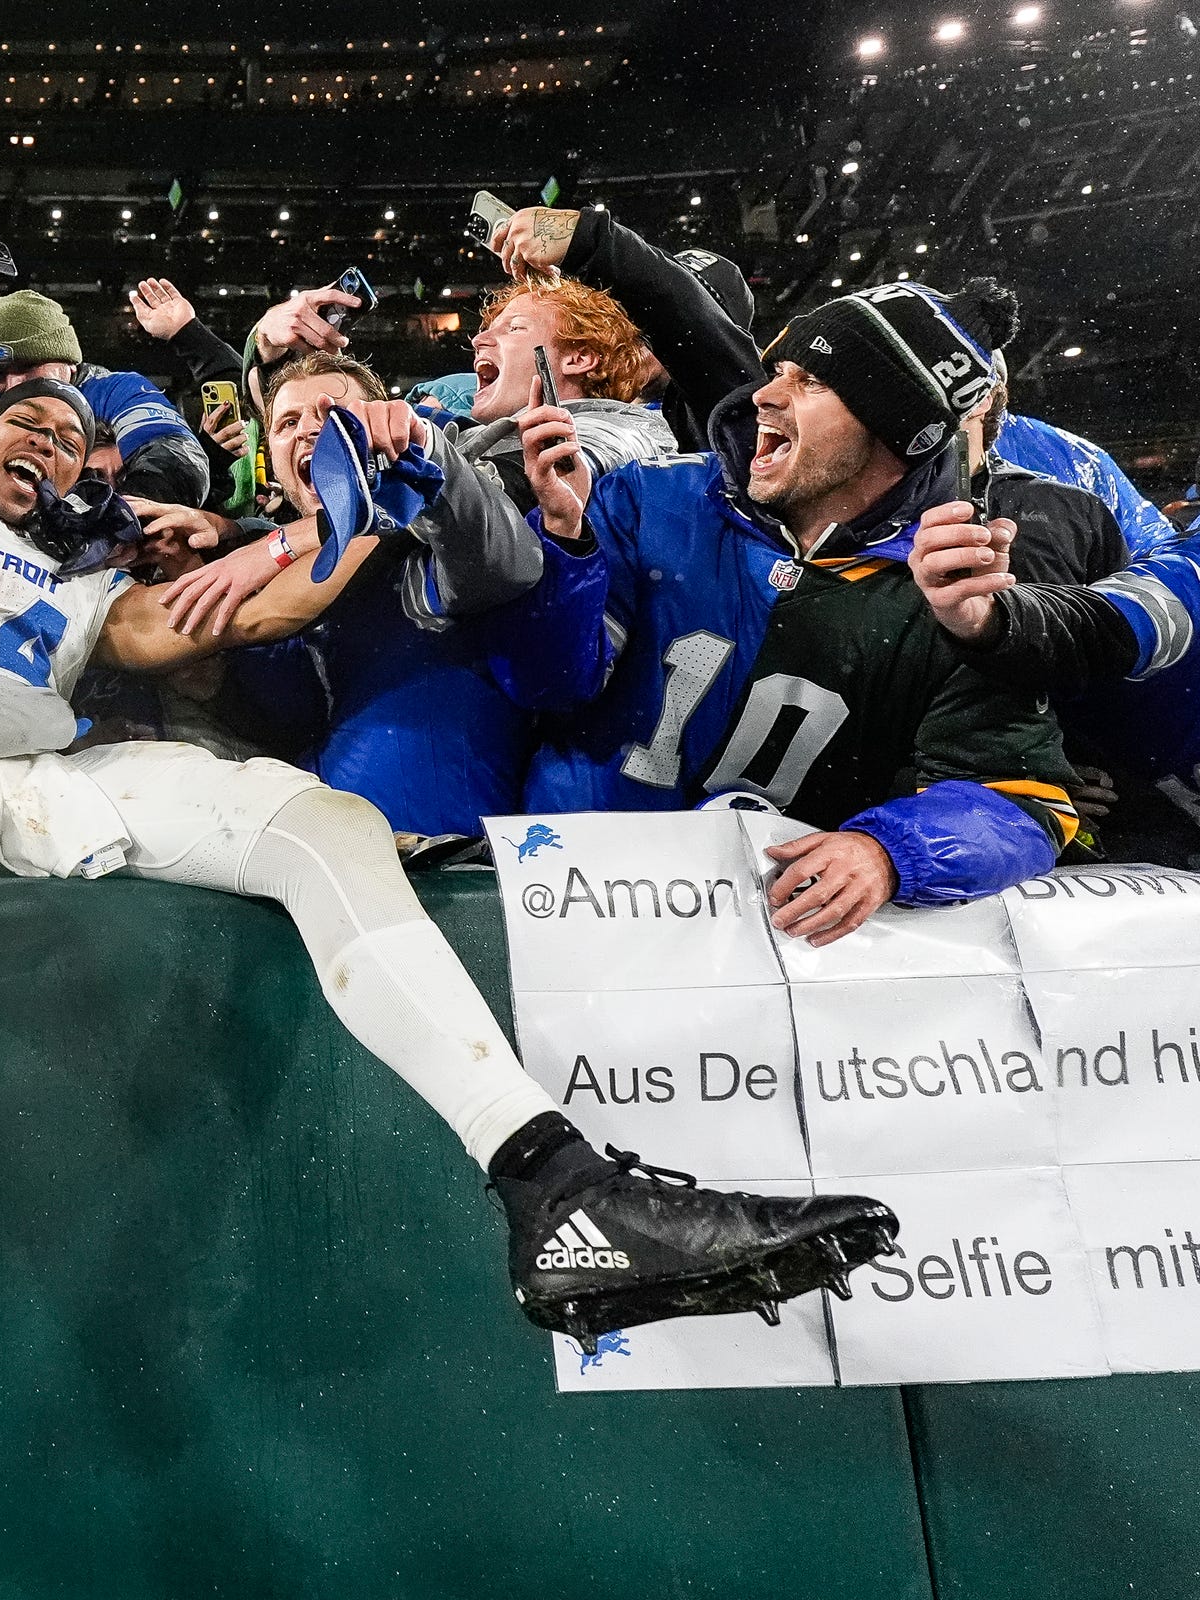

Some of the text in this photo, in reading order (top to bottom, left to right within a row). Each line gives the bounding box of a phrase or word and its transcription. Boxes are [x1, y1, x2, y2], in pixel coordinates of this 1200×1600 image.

[772, 571, 794, 588] NFL
[619, 629, 849, 808] 10
[522, 867, 742, 918] @Amon
[562, 1054, 676, 1105] Aus
[536, 1246, 631, 1270] adidas
[870, 1236, 1052, 1302] Selfie
